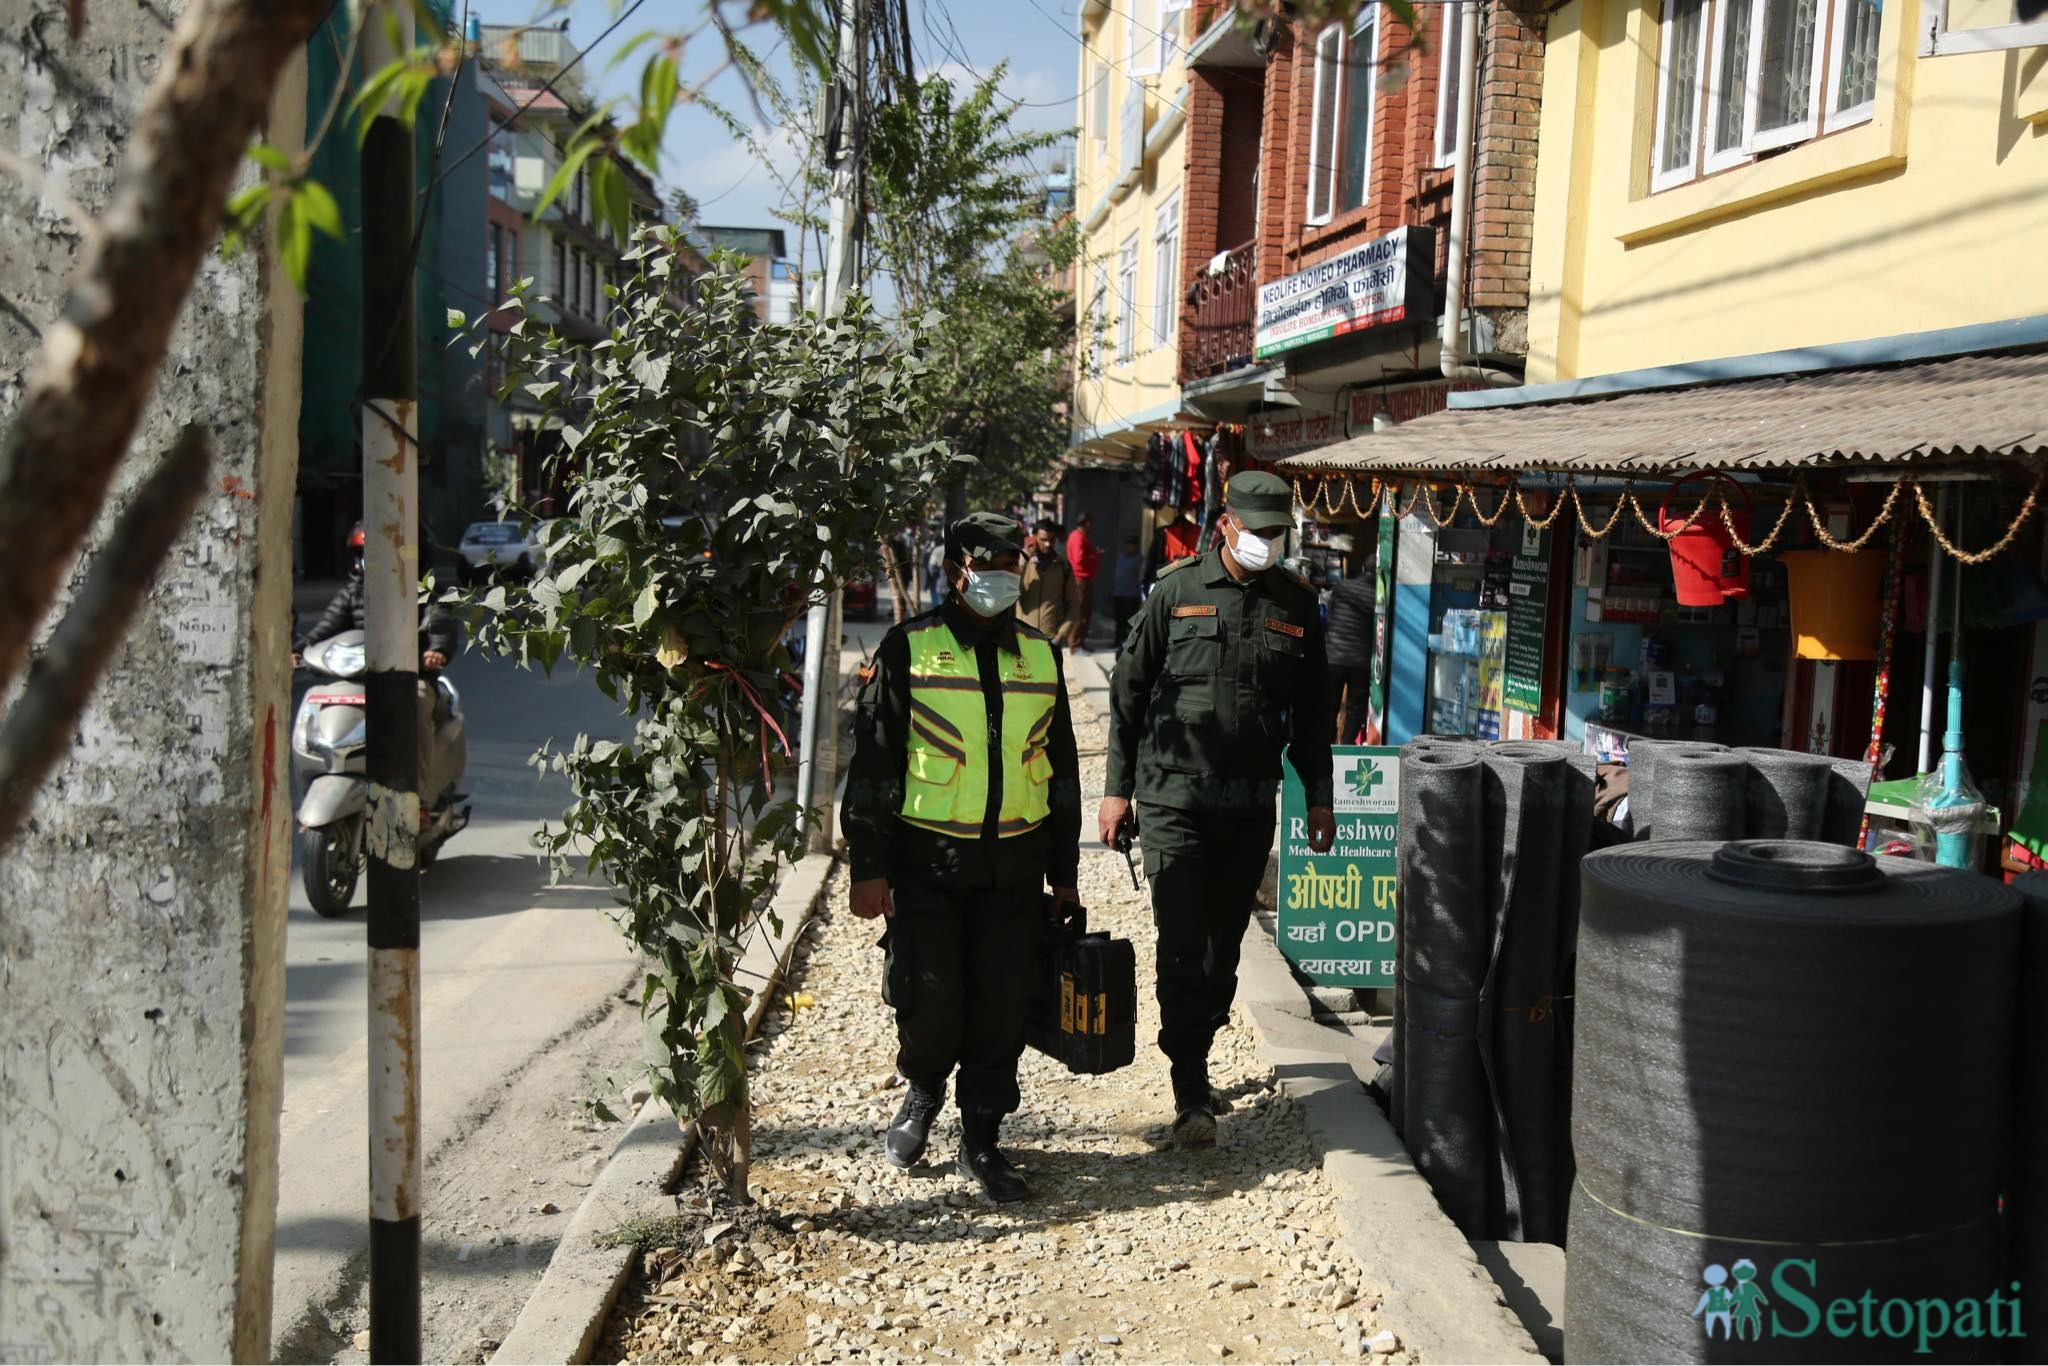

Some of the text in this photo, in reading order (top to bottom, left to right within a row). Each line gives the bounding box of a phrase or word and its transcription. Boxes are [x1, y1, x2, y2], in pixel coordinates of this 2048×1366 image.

[1263, 237, 1400, 305] NEOLIFE HOMEO PHARMACY
[1298, 302, 1349, 329] HOMEOPATHIC
[1340, 846, 1391, 858] Healthcare
[1287, 861, 1363, 911] औषधी
[1287, 920, 1395, 943] यहाँ OPD
[1299, 959, 1372, 977] व्यवस्था
